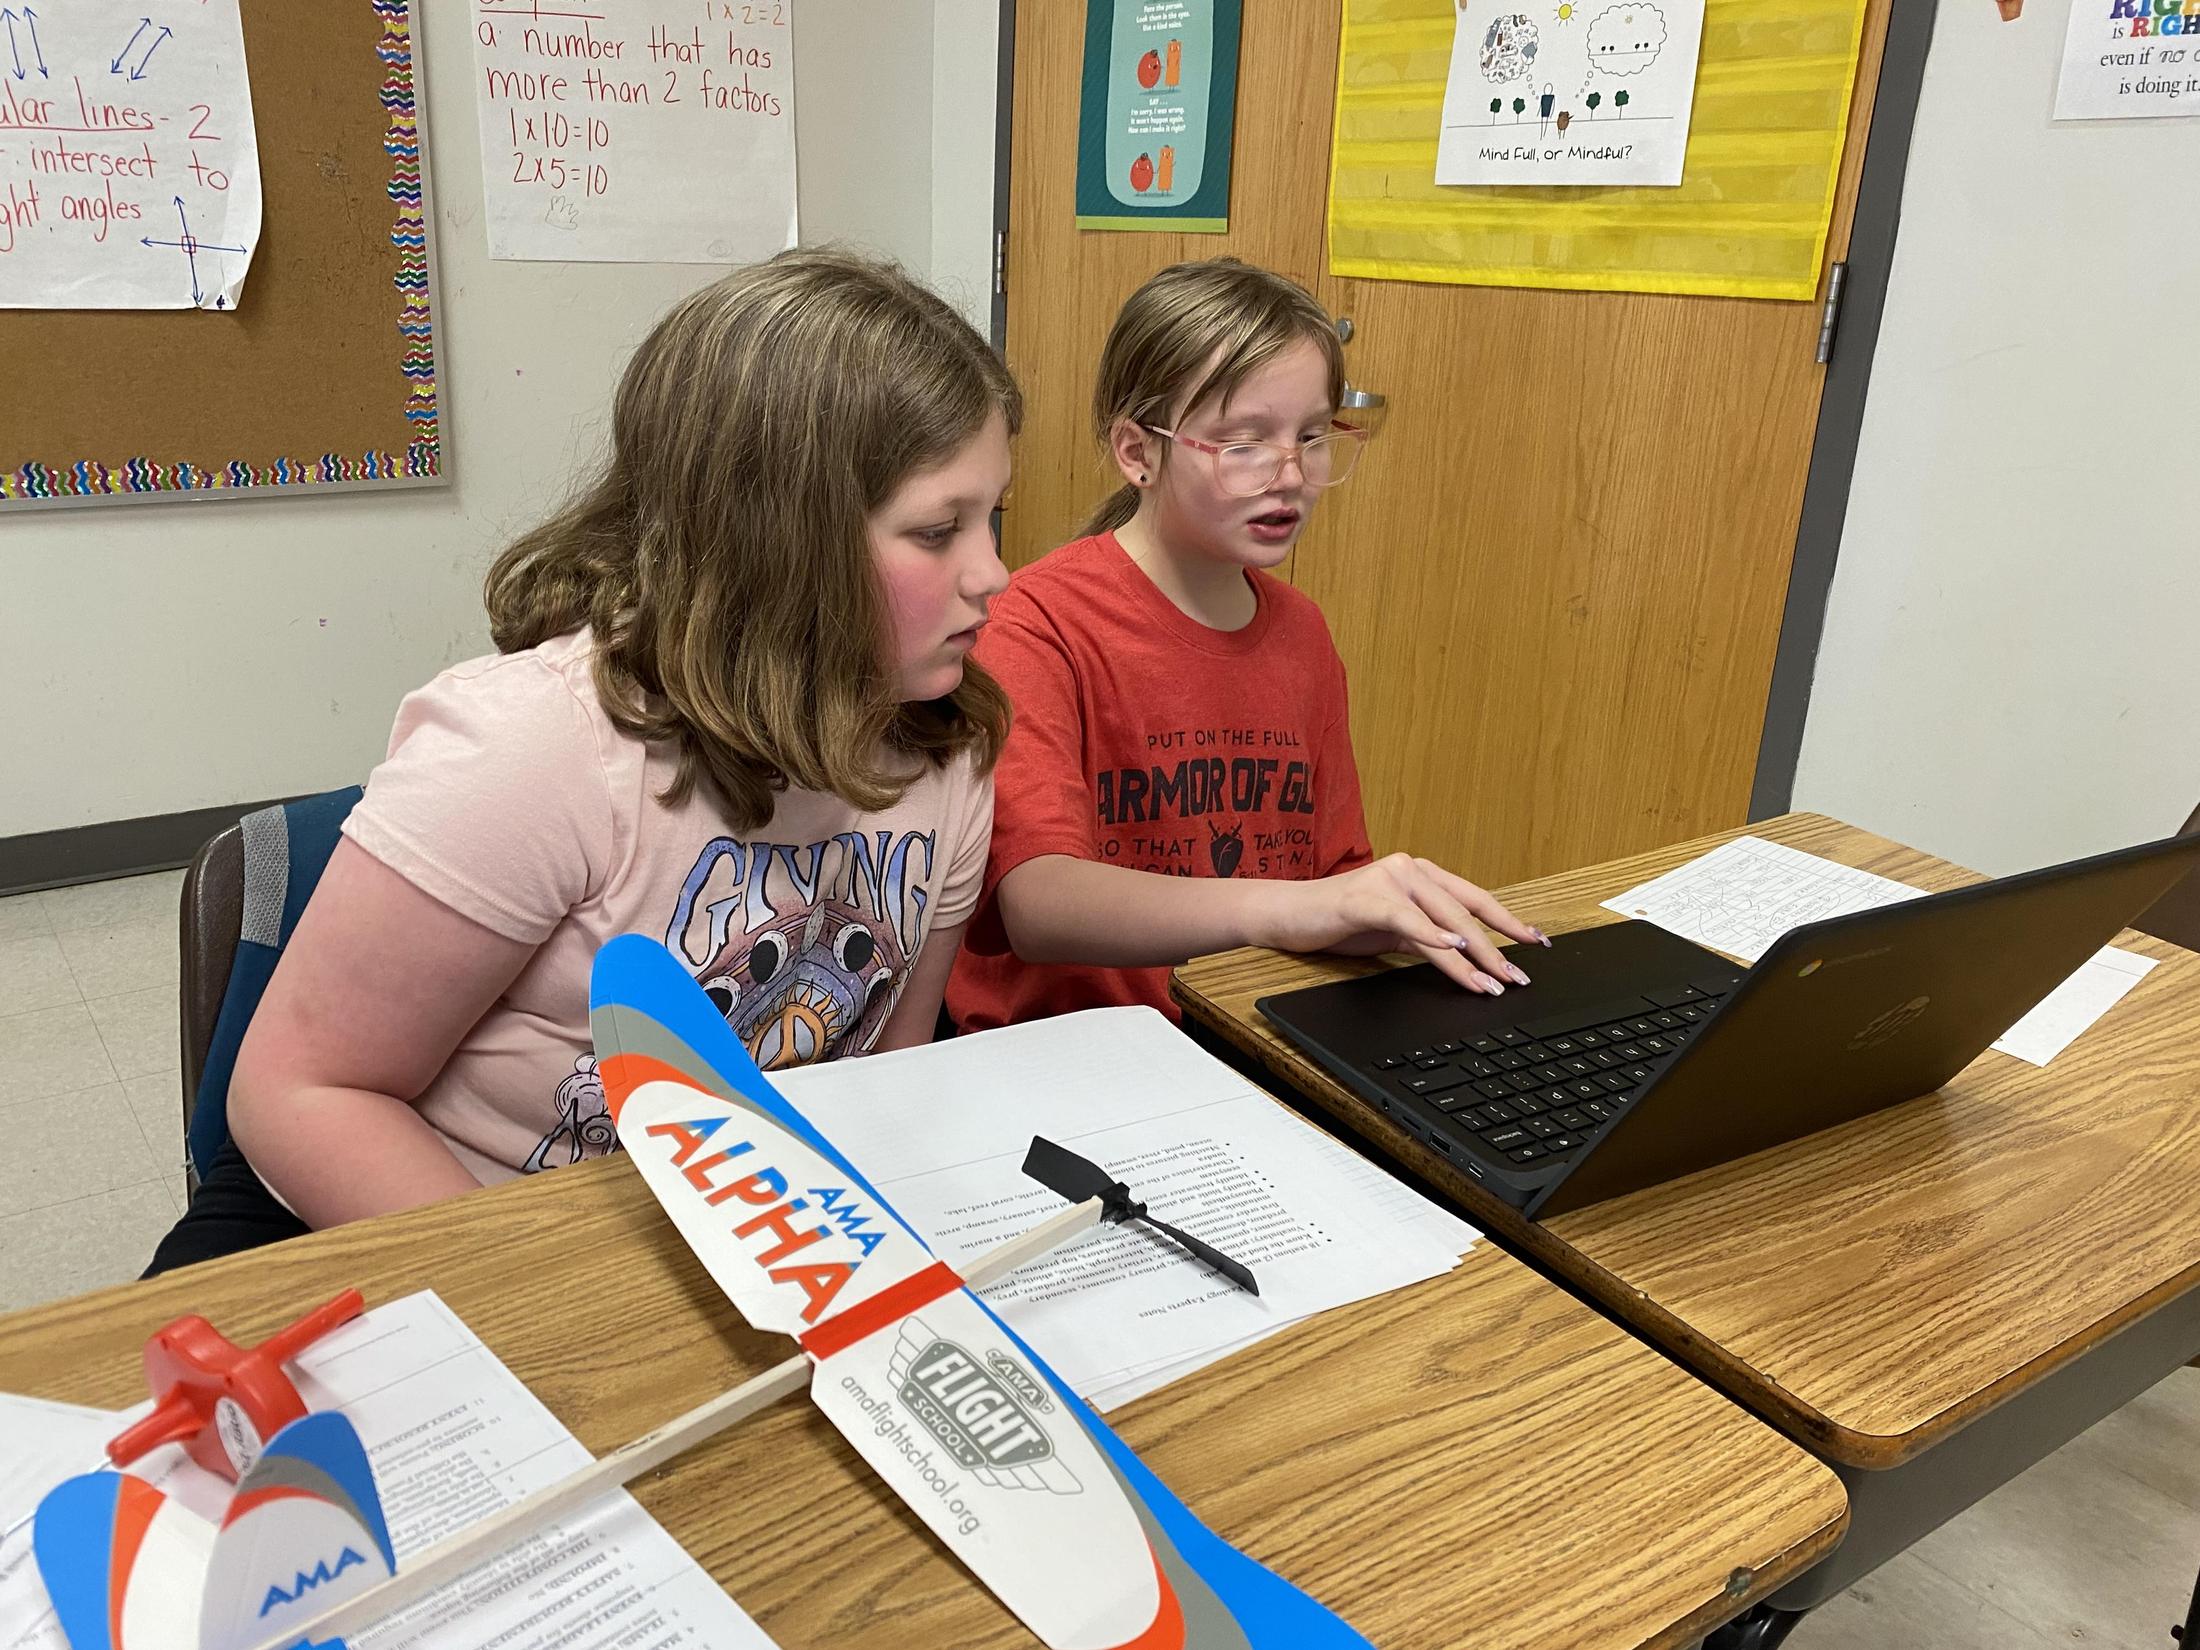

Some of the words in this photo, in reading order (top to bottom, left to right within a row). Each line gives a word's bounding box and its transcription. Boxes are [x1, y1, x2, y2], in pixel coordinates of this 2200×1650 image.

[478, 21, 497, 48] a
[524, 20, 624, 60] number
[647, 25, 706, 63] that
[729, 30, 771, 68] has
[2112, 21, 2124, 39] is
[2100, 52, 2134, 67] even
[2139, 46, 2155, 65] if
[2159, 48, 2187, 64] no
[487, 66, 567, 102] more
[582, 68, 649, 105] than
[664, 71, 681, 104] 2
[700, 69, 781, 117] factors
[2119, 77, 2131, 95] is
[2135, 75, 2182, 99] doing
[188, 105, 221, 140] 2
[31, 135, 157, 179] intersect
[188, 150, 229, 191] to
[1479, 148, 1509, 161] Mind
[1513, 147, 1540, 163] Full,
[1544, 149, 1563, 160] or
[1568, 145, 1633, 161] Mindful?
[61, 179, 142, 242] angles
[1147, 731, 1186, 749] PUT
[1195, 729, 1216, 745] ON
[1222, 729, 1255, 746] THE
[1263, 730, 1300, 746] FULL
[1097, 757, 1227, 826] ARMOR
[1231, 757, 1279, 813] OF
[1132, 837, 1197, 857] THAT
[645, 1117, 863, 1325] ALPHA
[1178, 1195, 1195, 1203] and
[807, 1189, 887, 1258] AMA
[1269, 1241, 1284, 1249] the
[916, 1352, 1042, 1460] FLIGHT
[997, 1361, 1040, 1404] AMA
[913, 1399, 968, 1456] SCHOOL
[841, 1376, 981, 1536] amaflightschool.org
[259, 1546, 366, 1618] AMA
